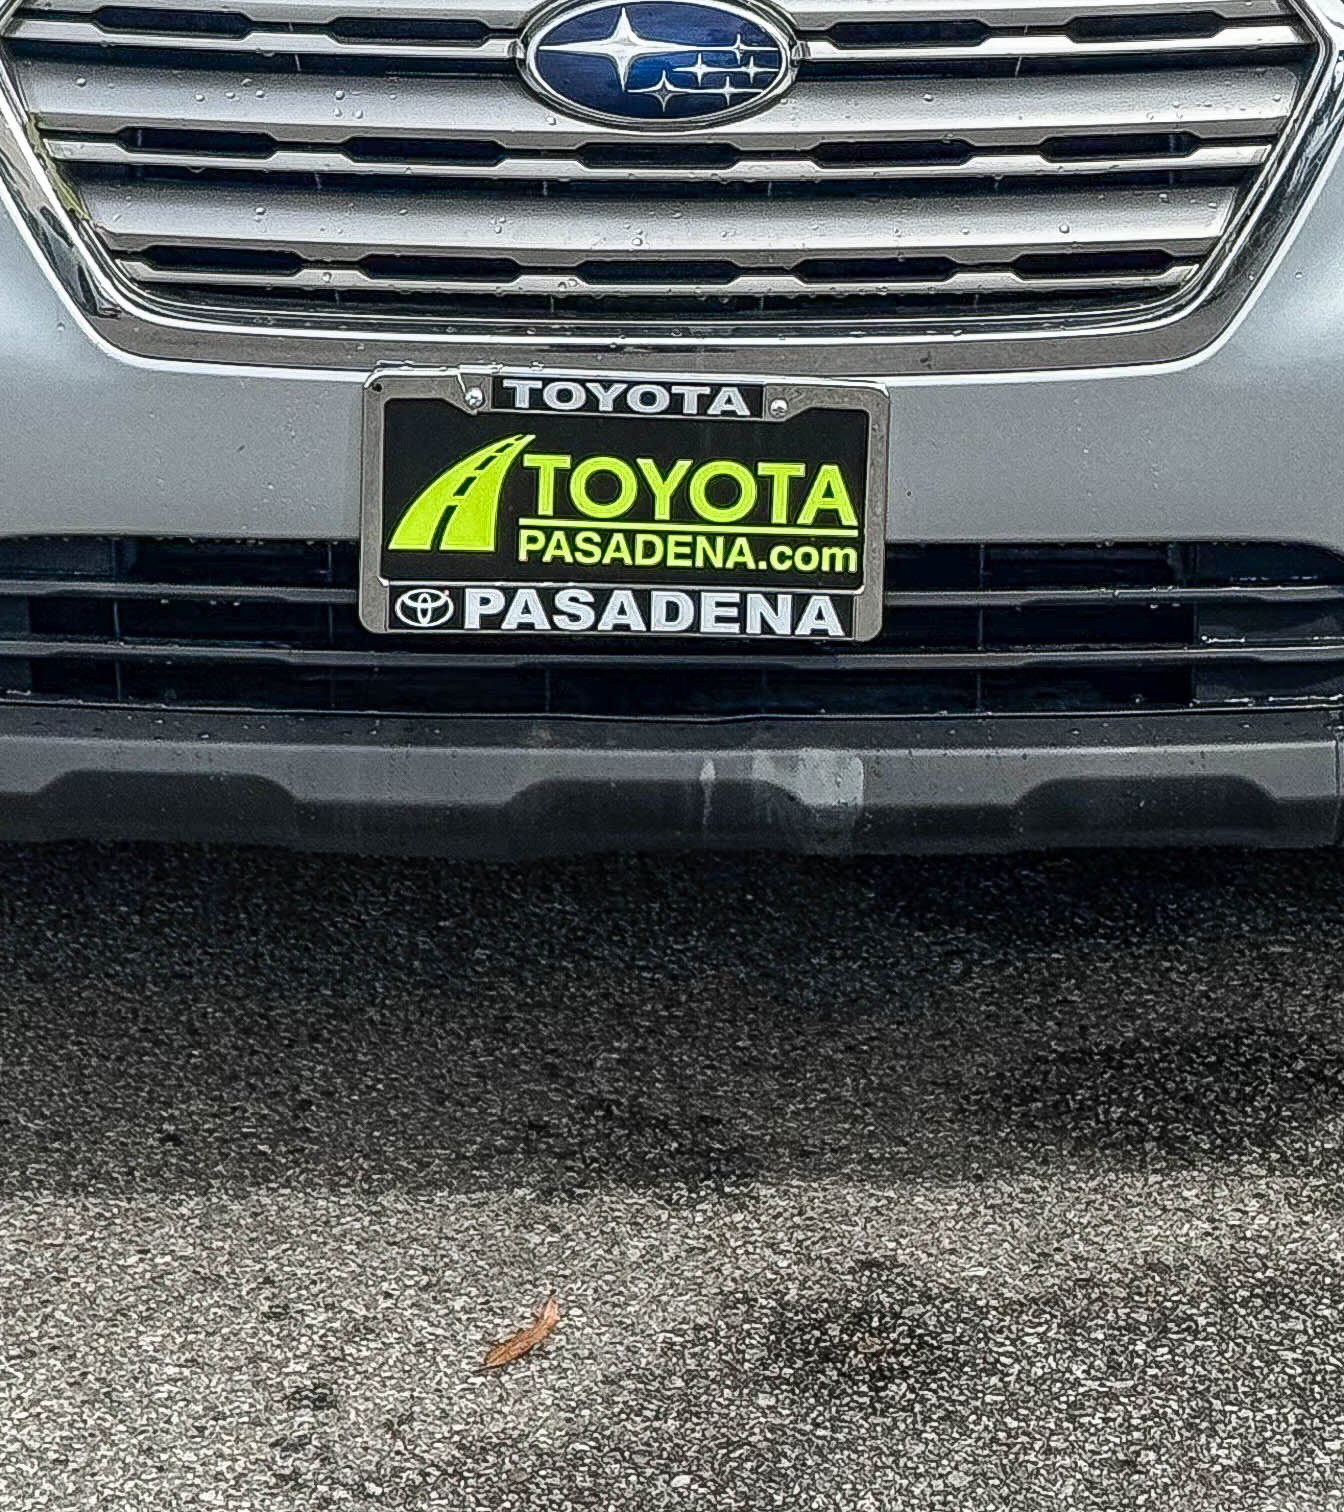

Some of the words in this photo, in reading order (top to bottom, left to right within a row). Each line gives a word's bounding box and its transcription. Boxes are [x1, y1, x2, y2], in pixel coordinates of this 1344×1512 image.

[502, 379, 750, 416] TOYOTA
[522, 453, 858, 526] TOYOTA
[519, 529, 857, 572] PASADENA.com
[464, 588, 845, 636] PASADENA
